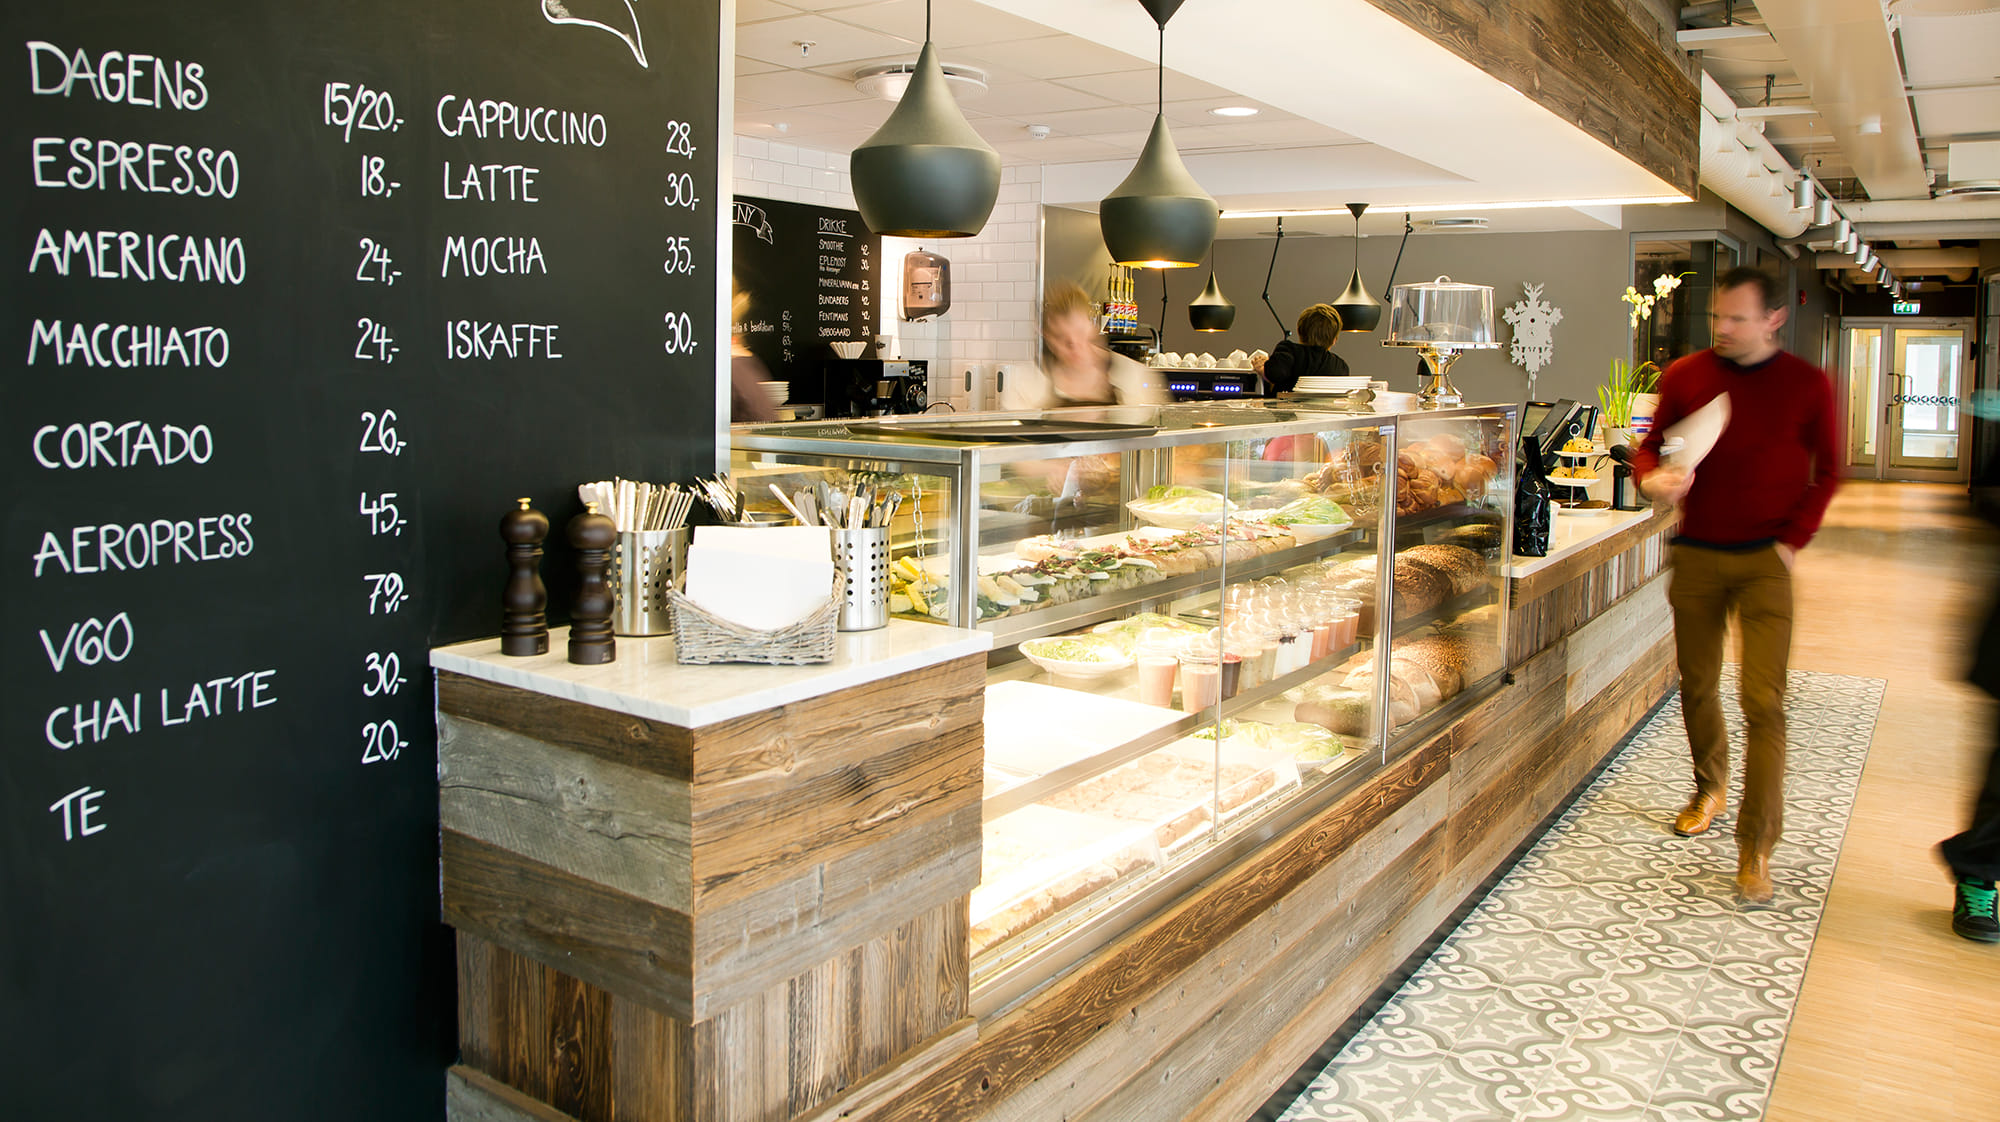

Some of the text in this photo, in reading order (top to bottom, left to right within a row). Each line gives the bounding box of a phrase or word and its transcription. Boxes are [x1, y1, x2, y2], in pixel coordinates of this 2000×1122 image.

[26, 40, 209, 111] DAGENS
[324, 81, 405, 144] 15/20,-
[436, 94, 607, 148] CAPPUCCINO
[665, 119, 697, 161] 28,-
[32, 137, 240, 199] ESPRESSO
[361, 154, 402, 198] 18,-
[443, 161, 540, 203] LATTE
[664, 172, 700, 212] 30,-
[732, 203, 757, 224] NY
[818, 217, 848, 234] DRIKKE
[818, 238, 845, 252] SMOOTHIE
[28, 228, 246, 285] AMERICANO
[356, 237, 403, 286] 24,-
[441, 235, 548, 278] MOCHA
[664, 236, 696, 276] 35,-
[818, 294, 850, 306] BUNDABERG
[818, 310, 849, 322] FENTIMANS
[27, 318, 230, 368] MACCHIATO
[354, 317, 400, 364] 24,-
[447, 319, 563, 361] ISKAFFE
[664, 311, 698, 356] 30,-
[33, 420, 213, 469] CORTADO
[359, 408, 407, 457] 26,-
[359, 491, 408, 537] 45,-
[33, 512, 254, 578] AEROPRESS
[363, 572, 409, 615] 79,-
[39, 611, 134, 673] V60
[362, 651, 408, 697] 30,-
[45, 669, 278, 750] CHAI LATTE
[361, 719, 409, 764] 20,-
[49, 786, 107, 841] TE
